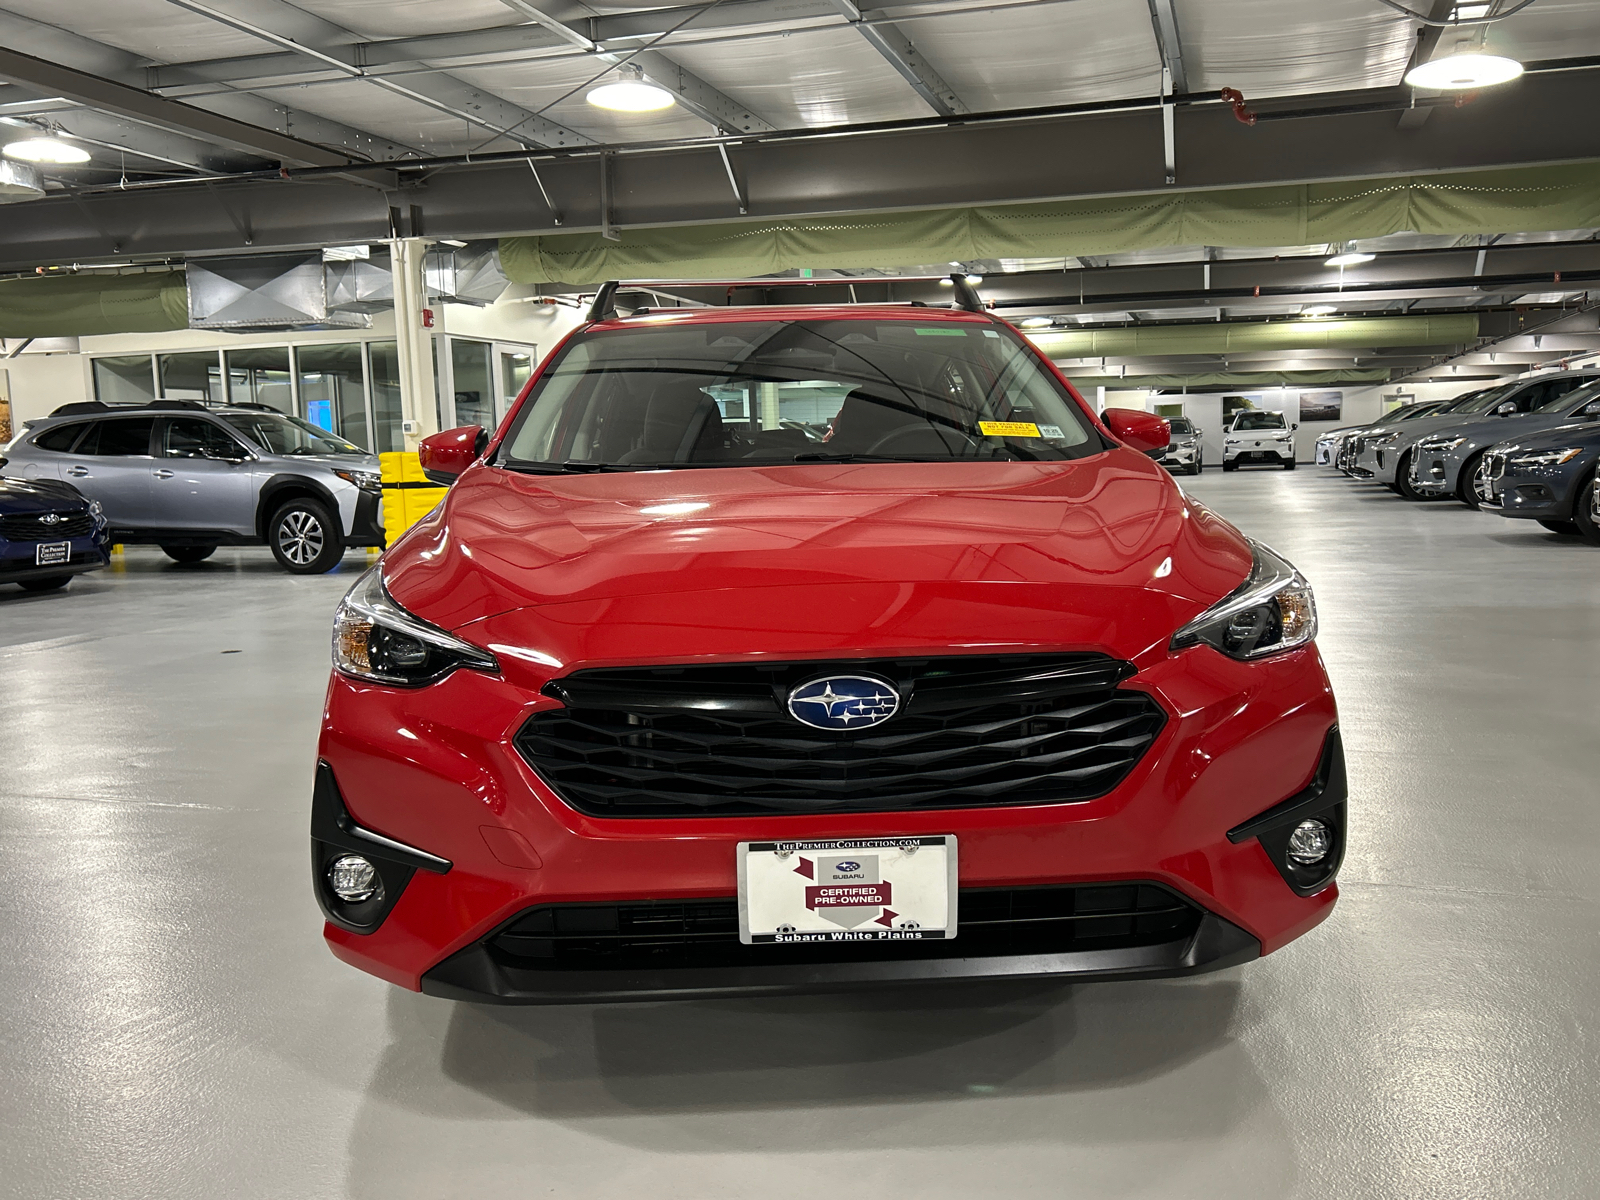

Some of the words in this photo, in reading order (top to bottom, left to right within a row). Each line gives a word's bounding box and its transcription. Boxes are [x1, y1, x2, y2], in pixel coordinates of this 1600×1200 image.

[820, 887, 877, 896] CERTIFIED
[814, 895, 882, 904] PRE-OWNED
[775, 933, 826, 942] Subaru
[831, 932, 873, 940] White
[878, 931, 922, 940] Plains
